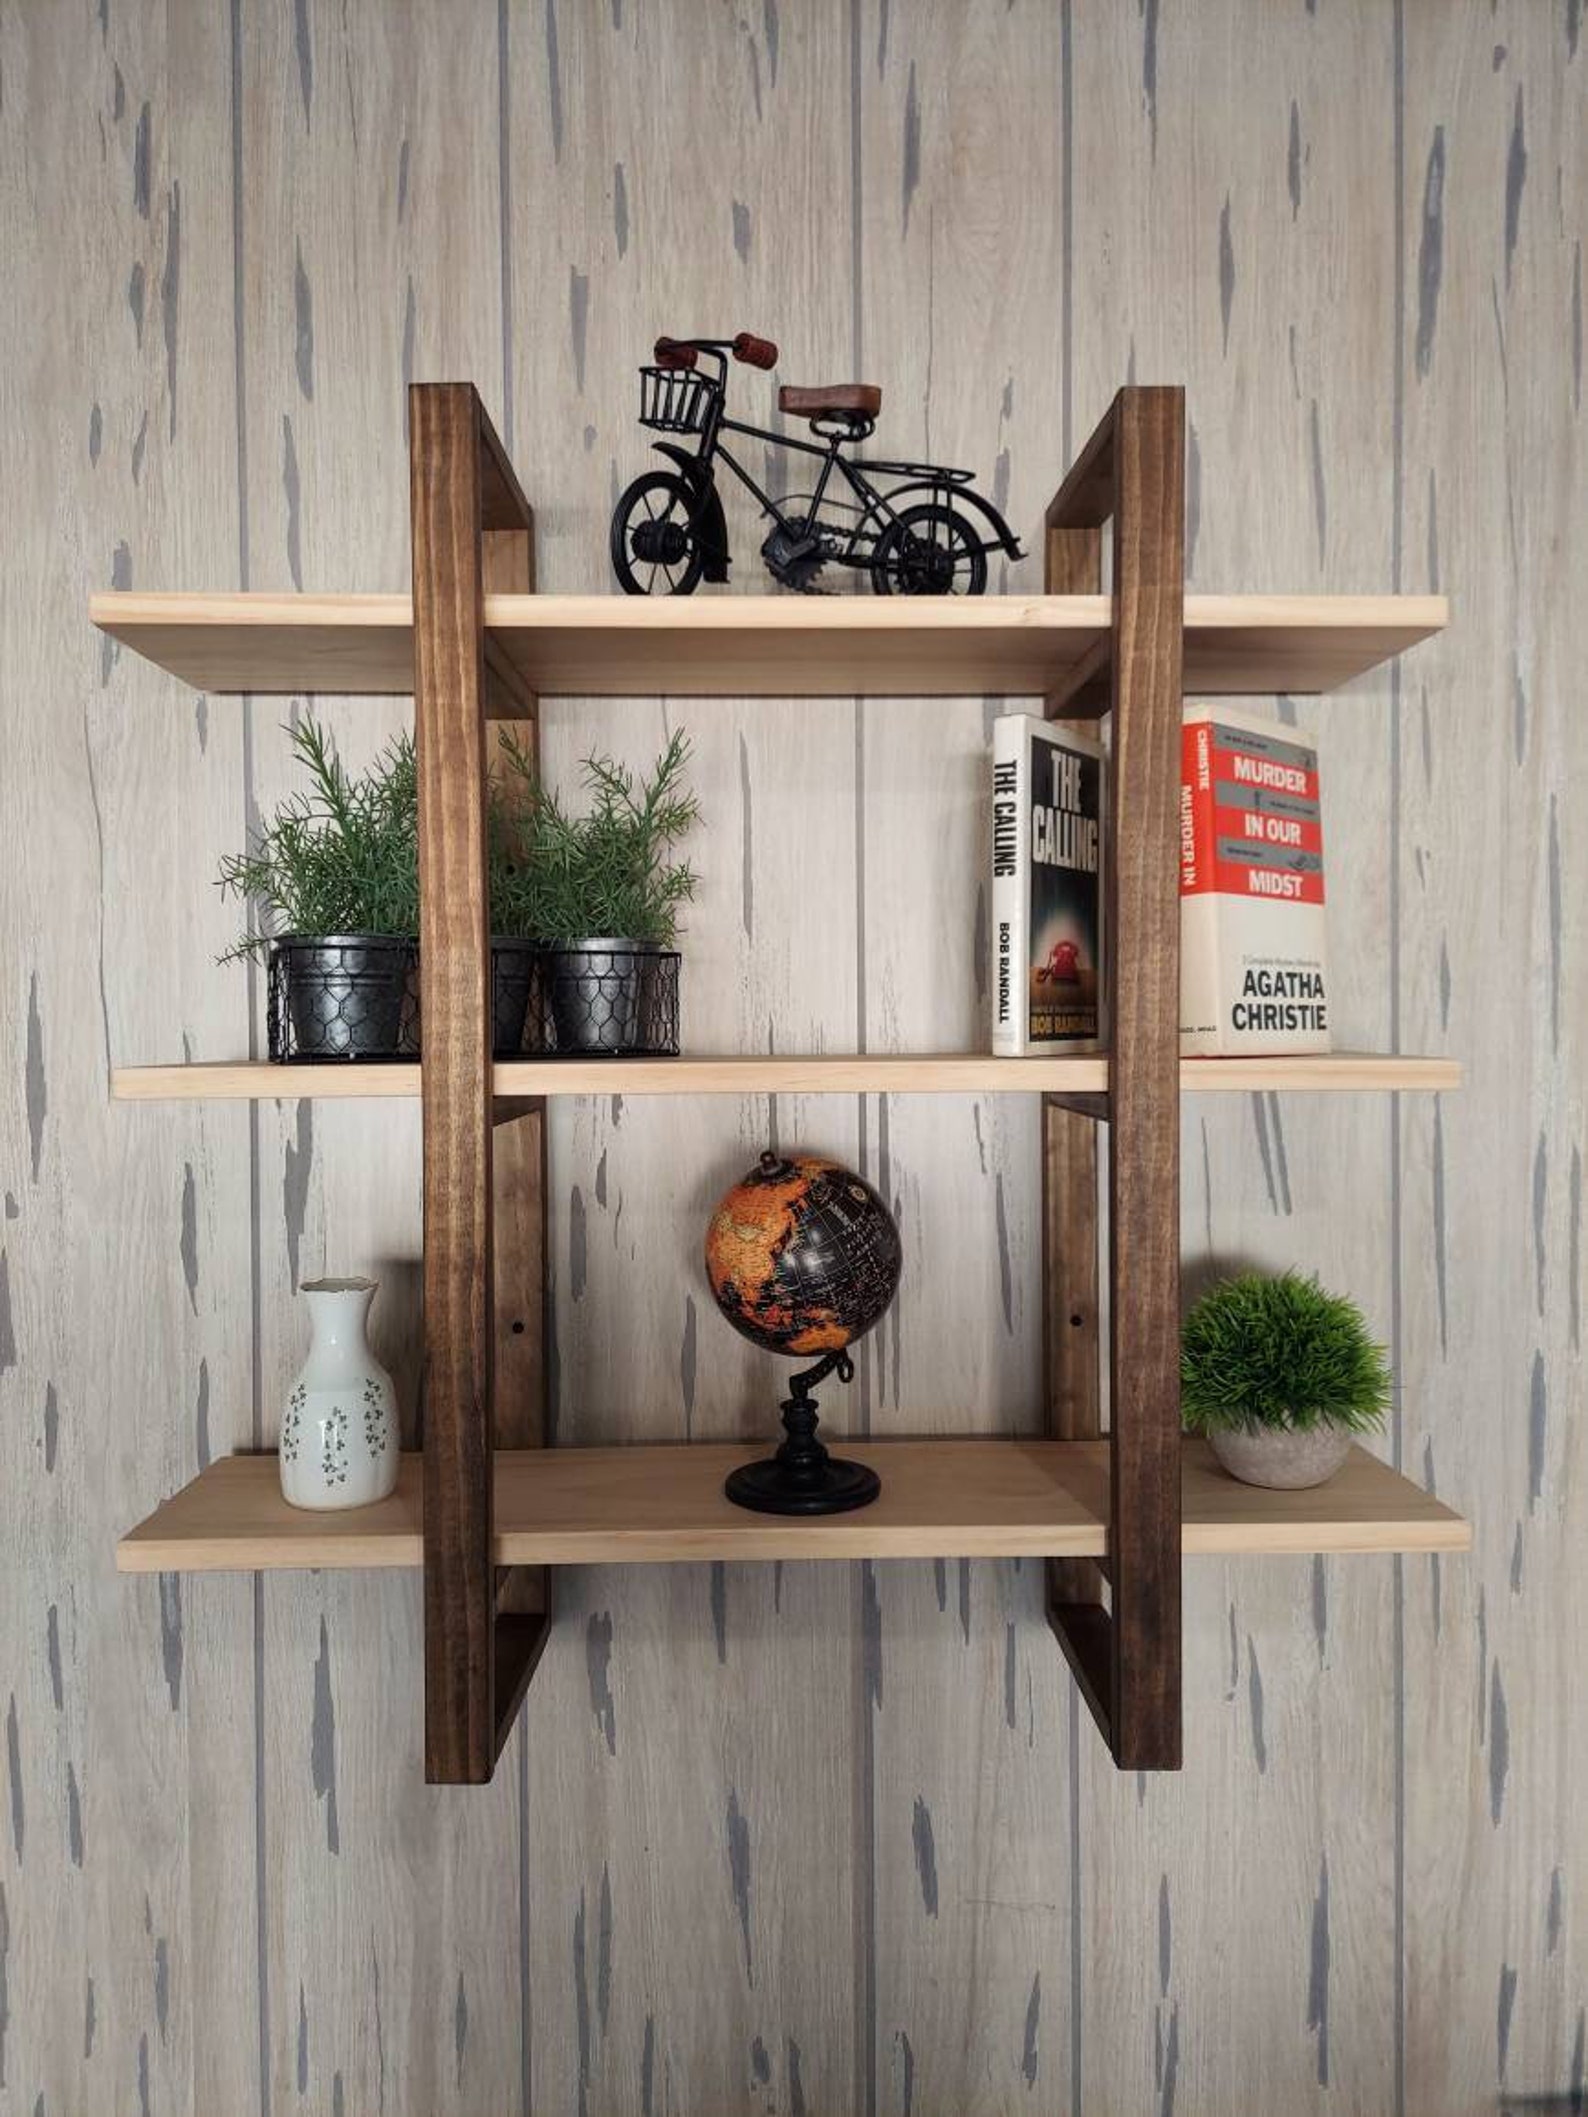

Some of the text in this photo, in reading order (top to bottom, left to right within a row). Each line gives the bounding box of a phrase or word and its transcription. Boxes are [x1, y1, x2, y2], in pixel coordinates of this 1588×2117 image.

[1051, 751, 1082, 813] THE
[1197, 729, 1210, 791] CHRISTIE
[1233, 756, 1307, 794] MURDER
[994, 760, 1017, 878] THE CALLING
[1032, 804, 1098, 872] CALLING
[1181, 785, 1196, 886] MURDER IN
[1244, 813, 1301, 845] IN OUR
[1248, 869, 1303, 898] MIDST
[999, 922, 1010, 1024] BOB RANDALL
[1242, 969, 1325, 999] AGATHA
[1232, 1003, 1327, 1032] CHRISTIE
